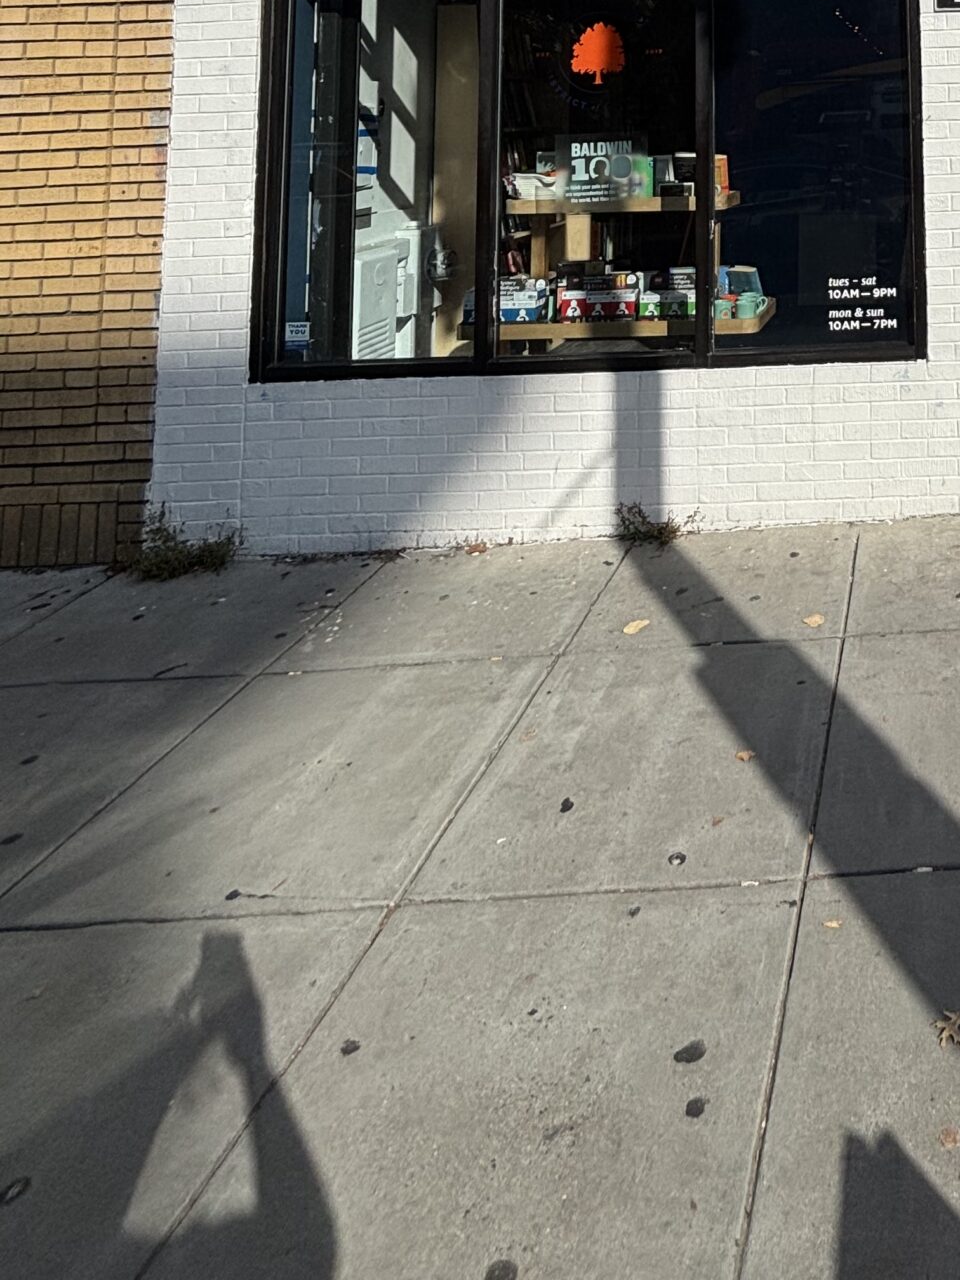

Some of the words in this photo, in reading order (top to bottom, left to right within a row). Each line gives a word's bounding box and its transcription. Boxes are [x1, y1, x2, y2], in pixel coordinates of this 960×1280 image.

[570, 140, 632, 157] BALDWIN
[828, 278, 850, 287] tues
[861, 276, 877, 286] sat
[829, 310, 852, 318] mon
[854, 307, 864, 317] &
[866, 308, 885, 317] sun
